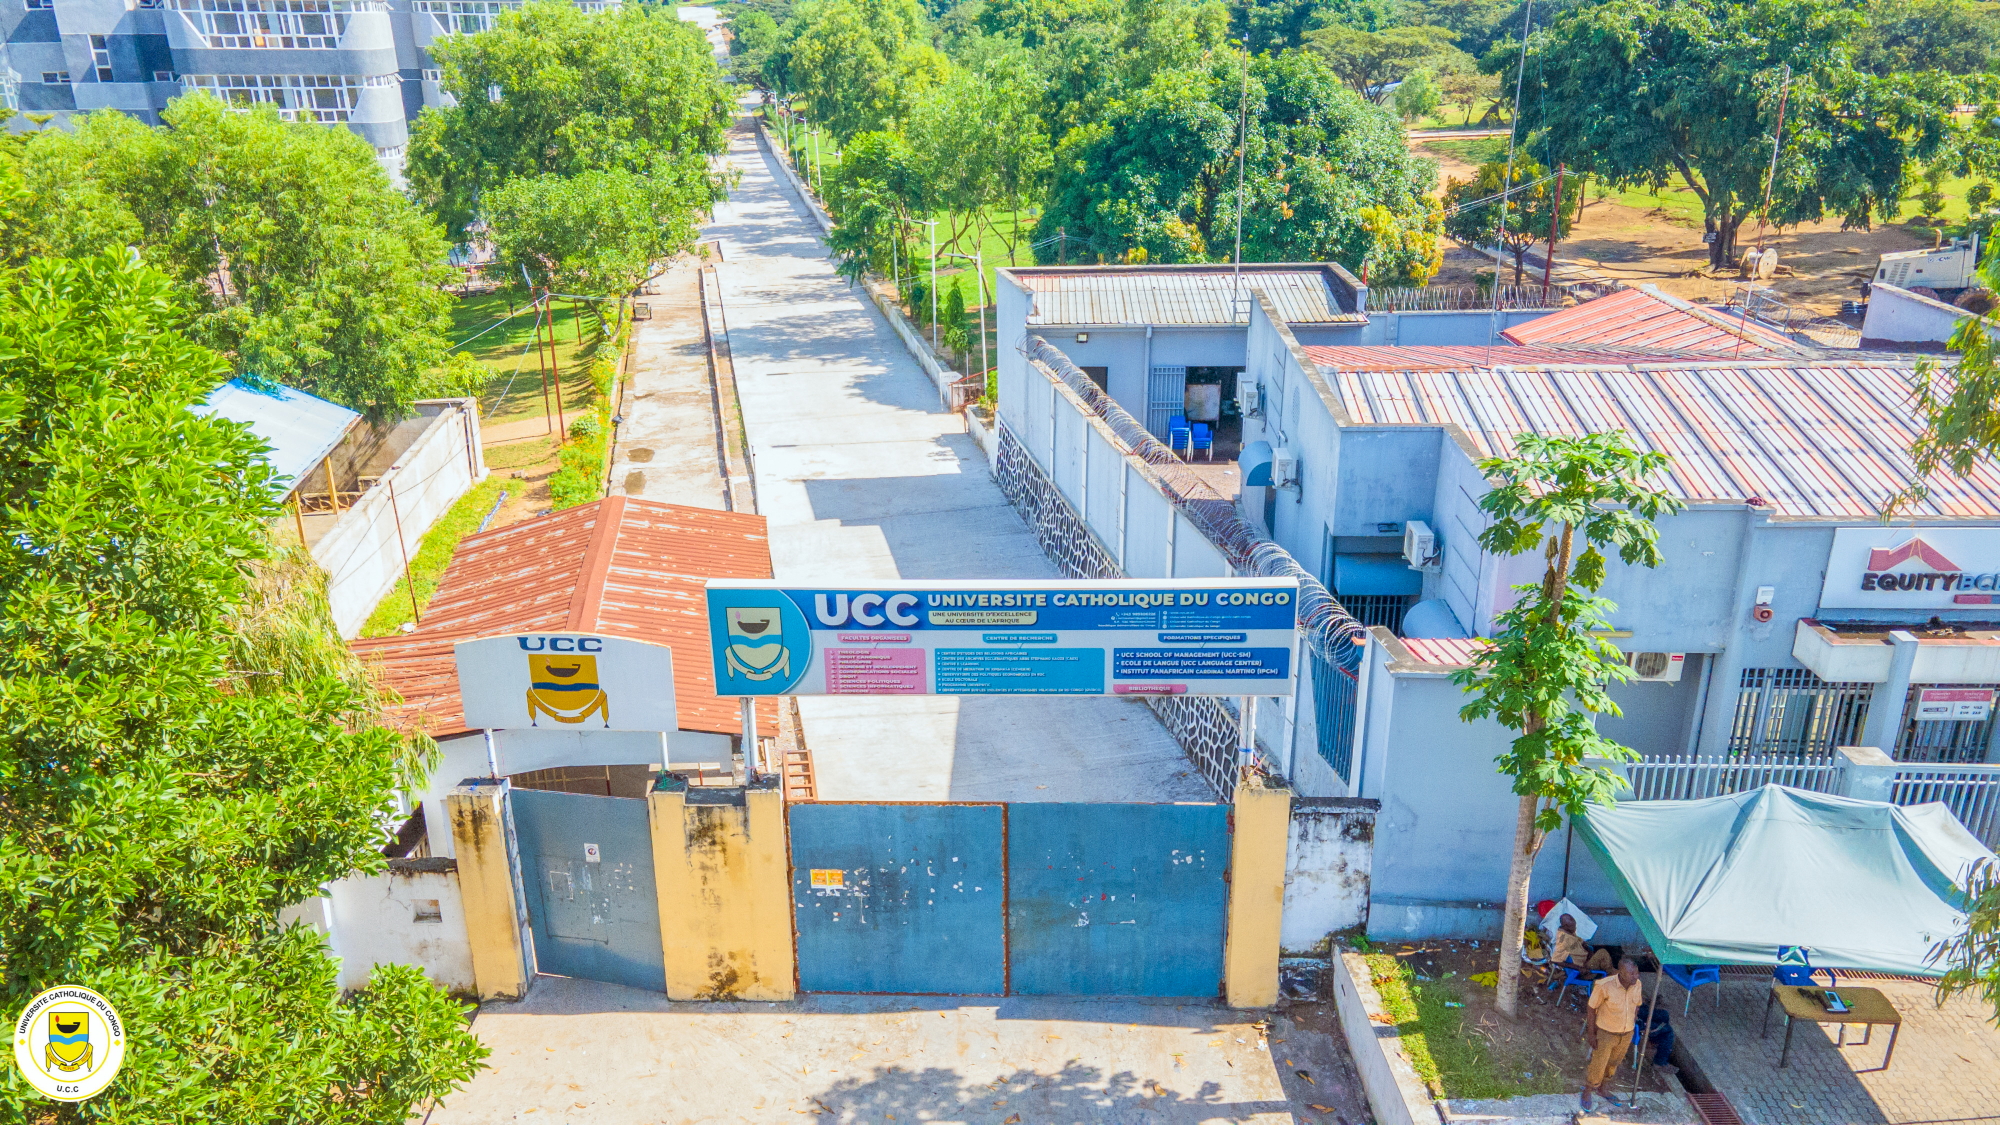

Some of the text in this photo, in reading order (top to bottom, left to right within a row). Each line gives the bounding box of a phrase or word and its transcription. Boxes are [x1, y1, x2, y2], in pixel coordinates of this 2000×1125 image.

[927, 592, 1290, 608] UNIVERSITE CATHOLIQUE DU CONGO
[814, 593, 919, 626] UCC
[516, 636, 603, 653] UCC
